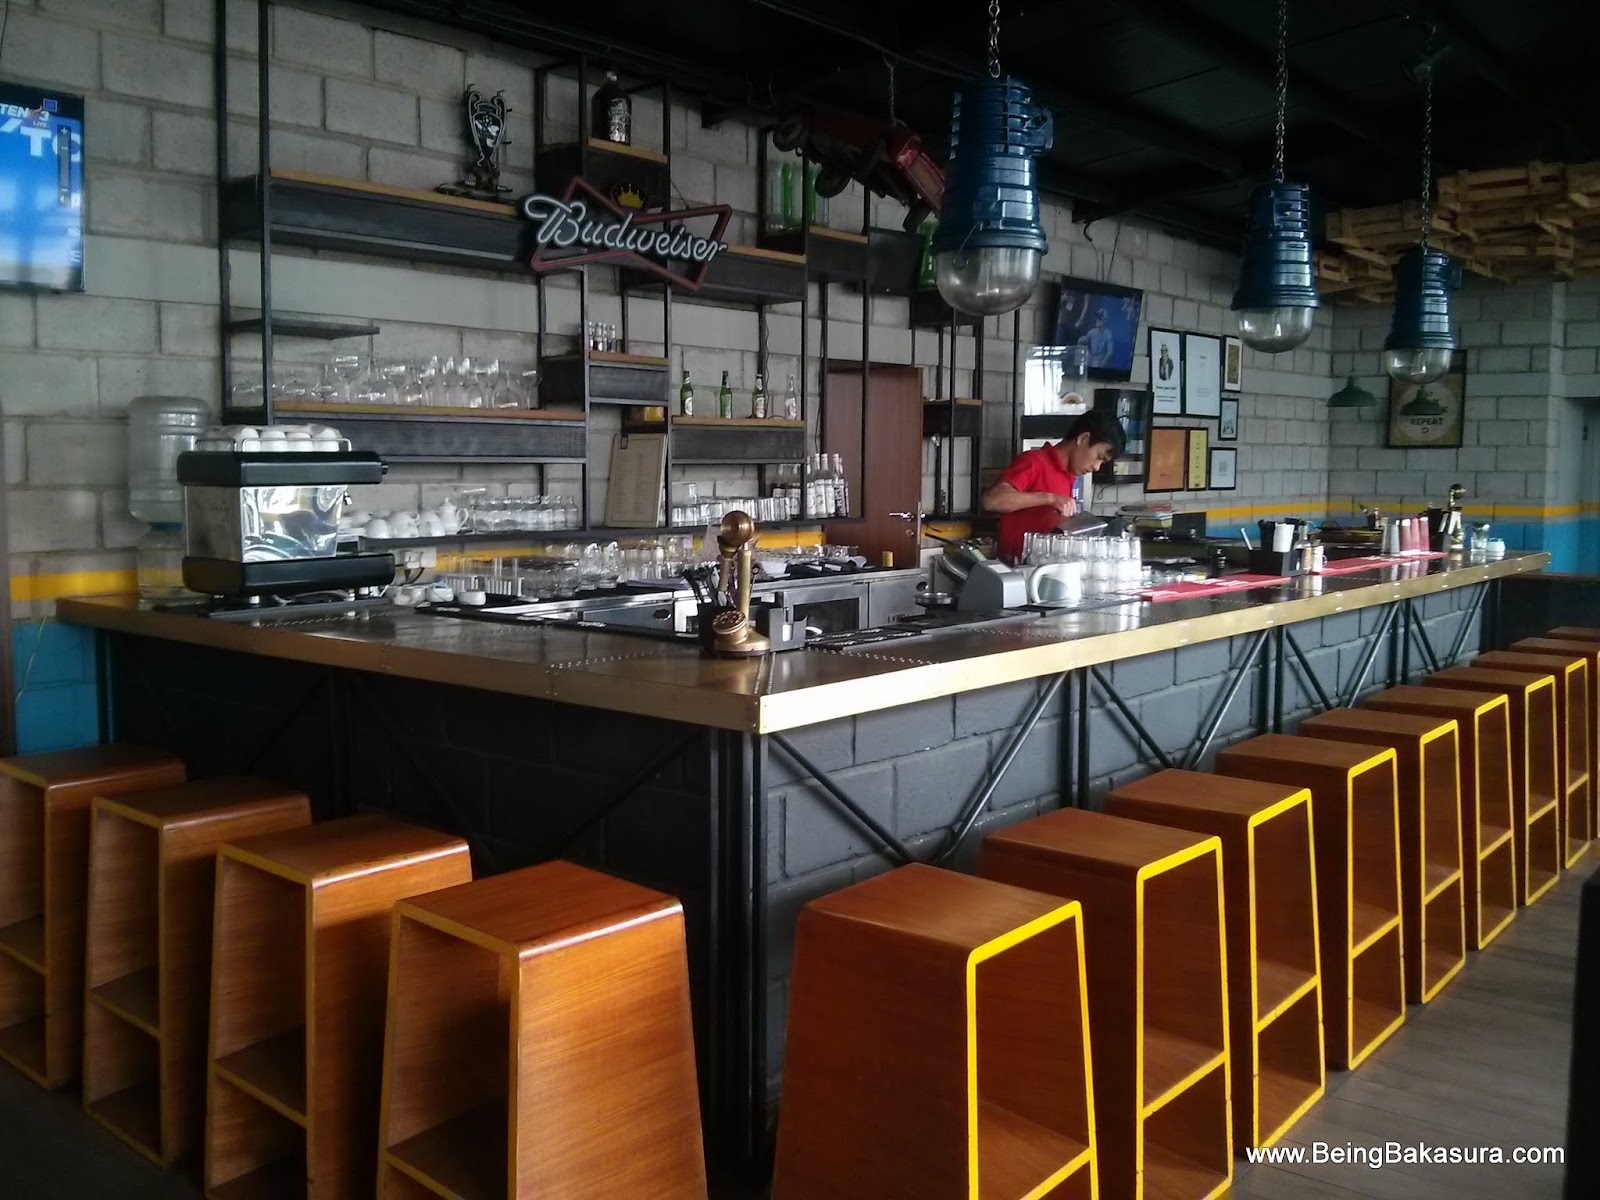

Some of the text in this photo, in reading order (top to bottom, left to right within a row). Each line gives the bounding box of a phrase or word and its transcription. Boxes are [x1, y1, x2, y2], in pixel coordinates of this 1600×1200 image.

[0, 103, 30, 118] TEN
[524, 195, 728, 262] Budweiser
[1410, 417, 1443, 426] REPEAT
